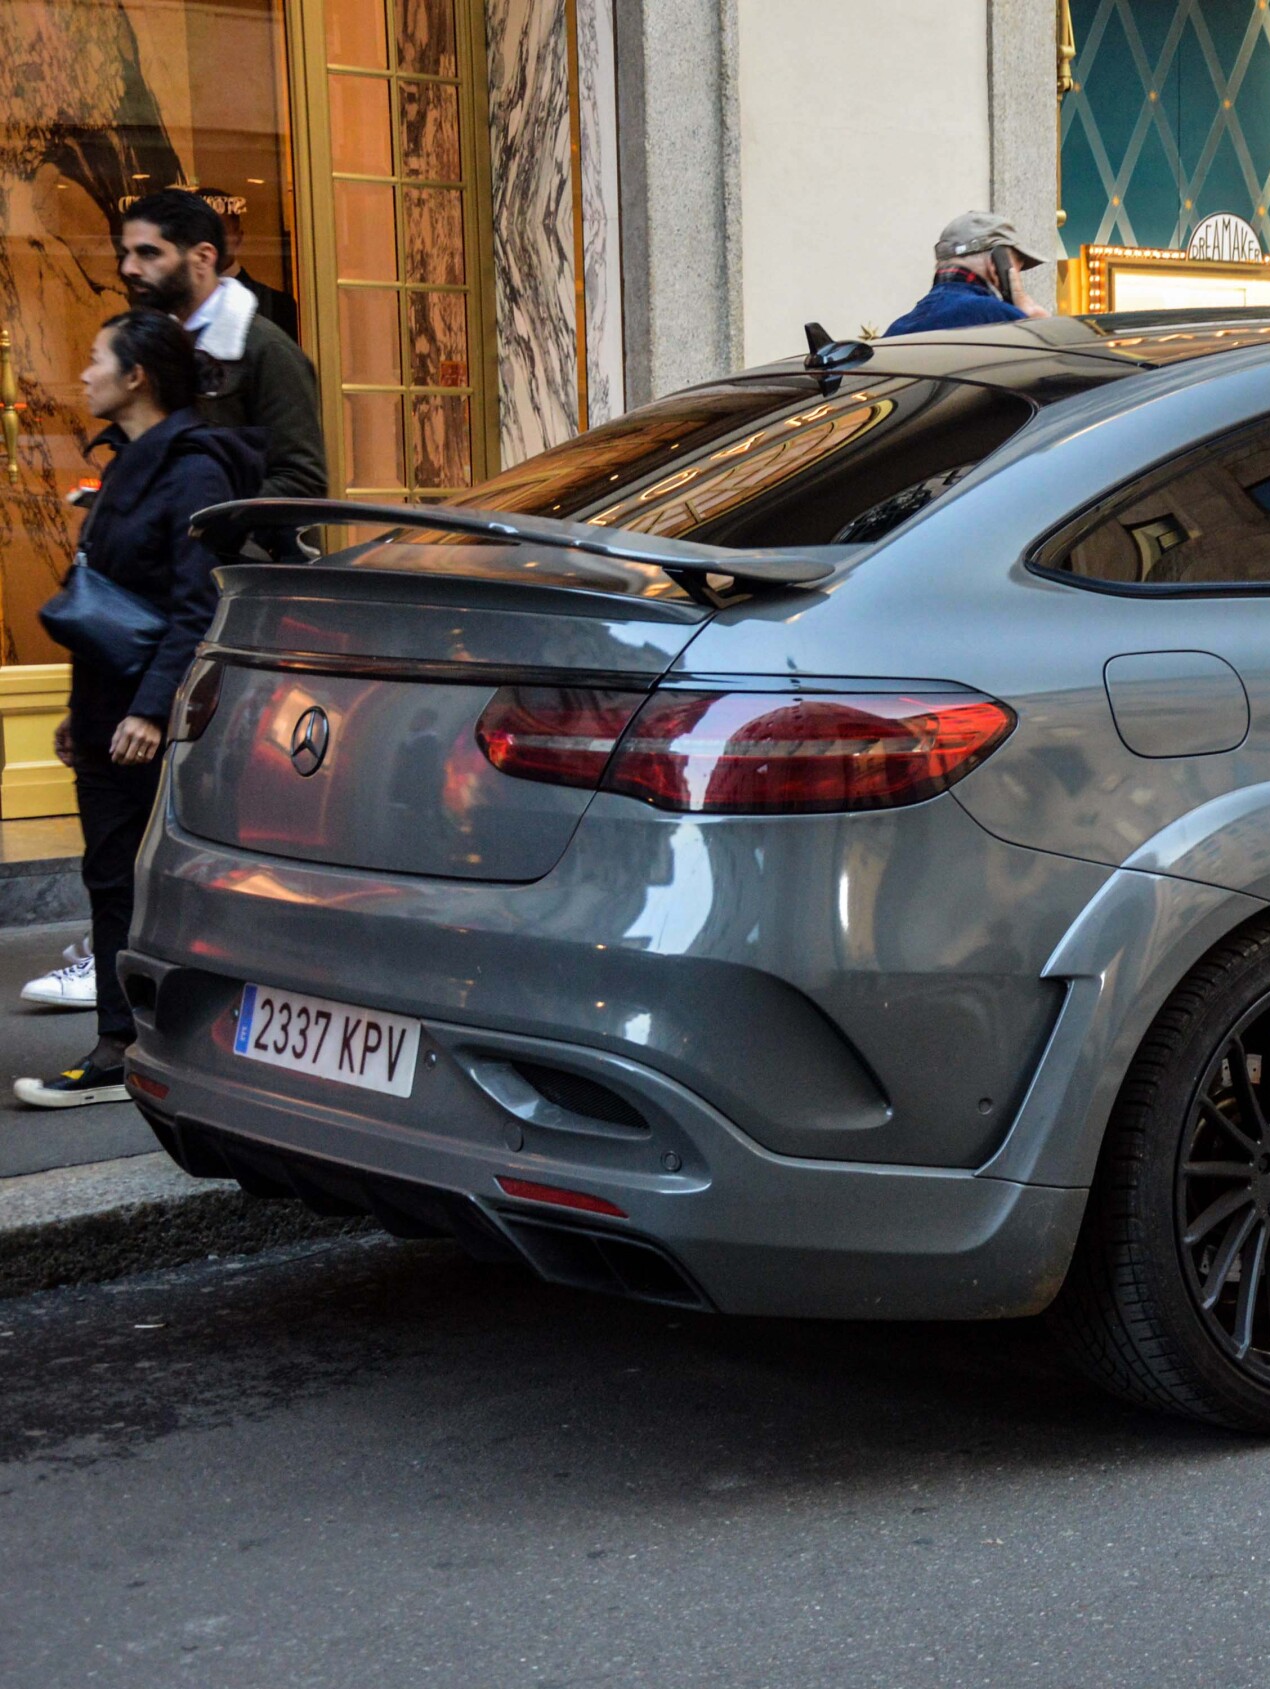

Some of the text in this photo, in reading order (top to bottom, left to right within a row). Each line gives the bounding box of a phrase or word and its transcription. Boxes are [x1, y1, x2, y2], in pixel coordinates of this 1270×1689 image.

[1191, 216, 1261, 263] DREAMAKER
[254, 998, 407, 1082] 2337 KPV
